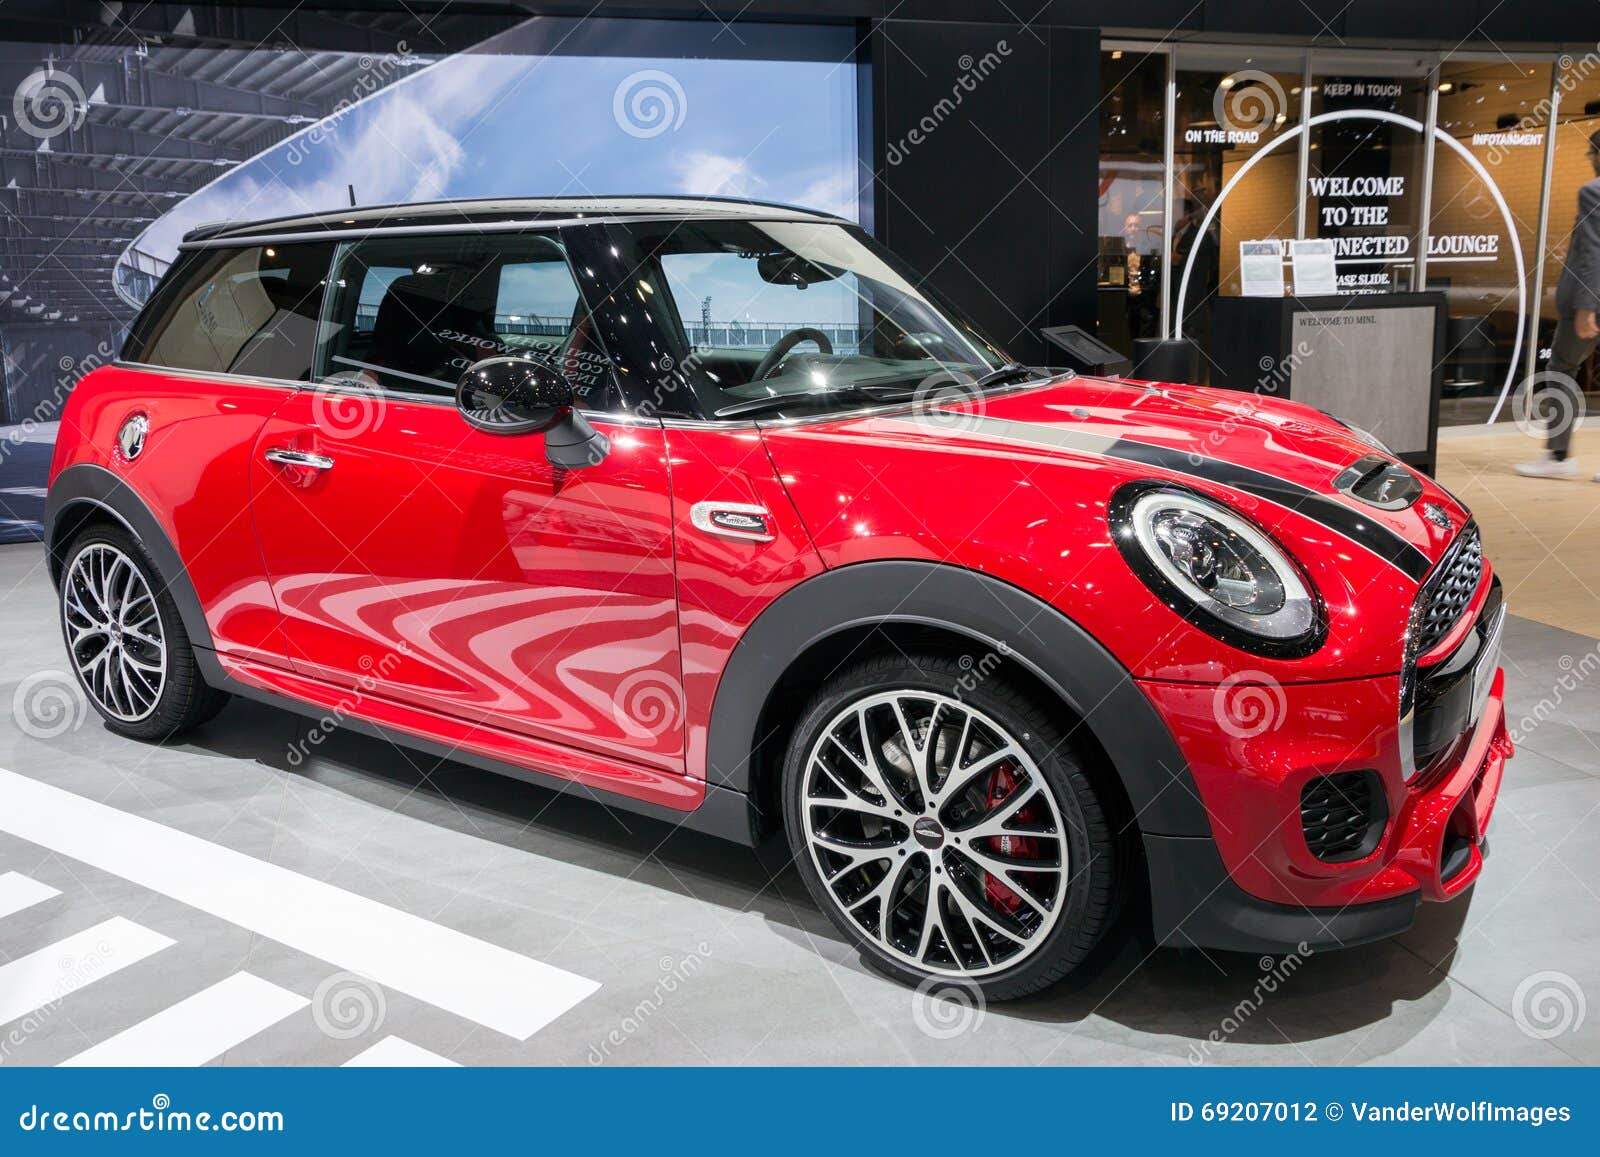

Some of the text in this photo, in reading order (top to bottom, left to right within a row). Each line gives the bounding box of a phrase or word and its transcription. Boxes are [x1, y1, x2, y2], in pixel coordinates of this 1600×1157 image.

[1324, 84, 1402, 97] KEEP IN TOUCH
[1185, 130, 1260, 144] ON THE ROAD
[1472, 133, 1543, 146] INFOTAINMENT
[1308, 176, 1405, 197] WELCOME
[1321, 206, 1389, 226] TO THE
[1427, 234, 1499, 256] LOUNGE
[1299, 317, 1342, 327] WELCOME
[1343, 316, 1354, 325] TO
